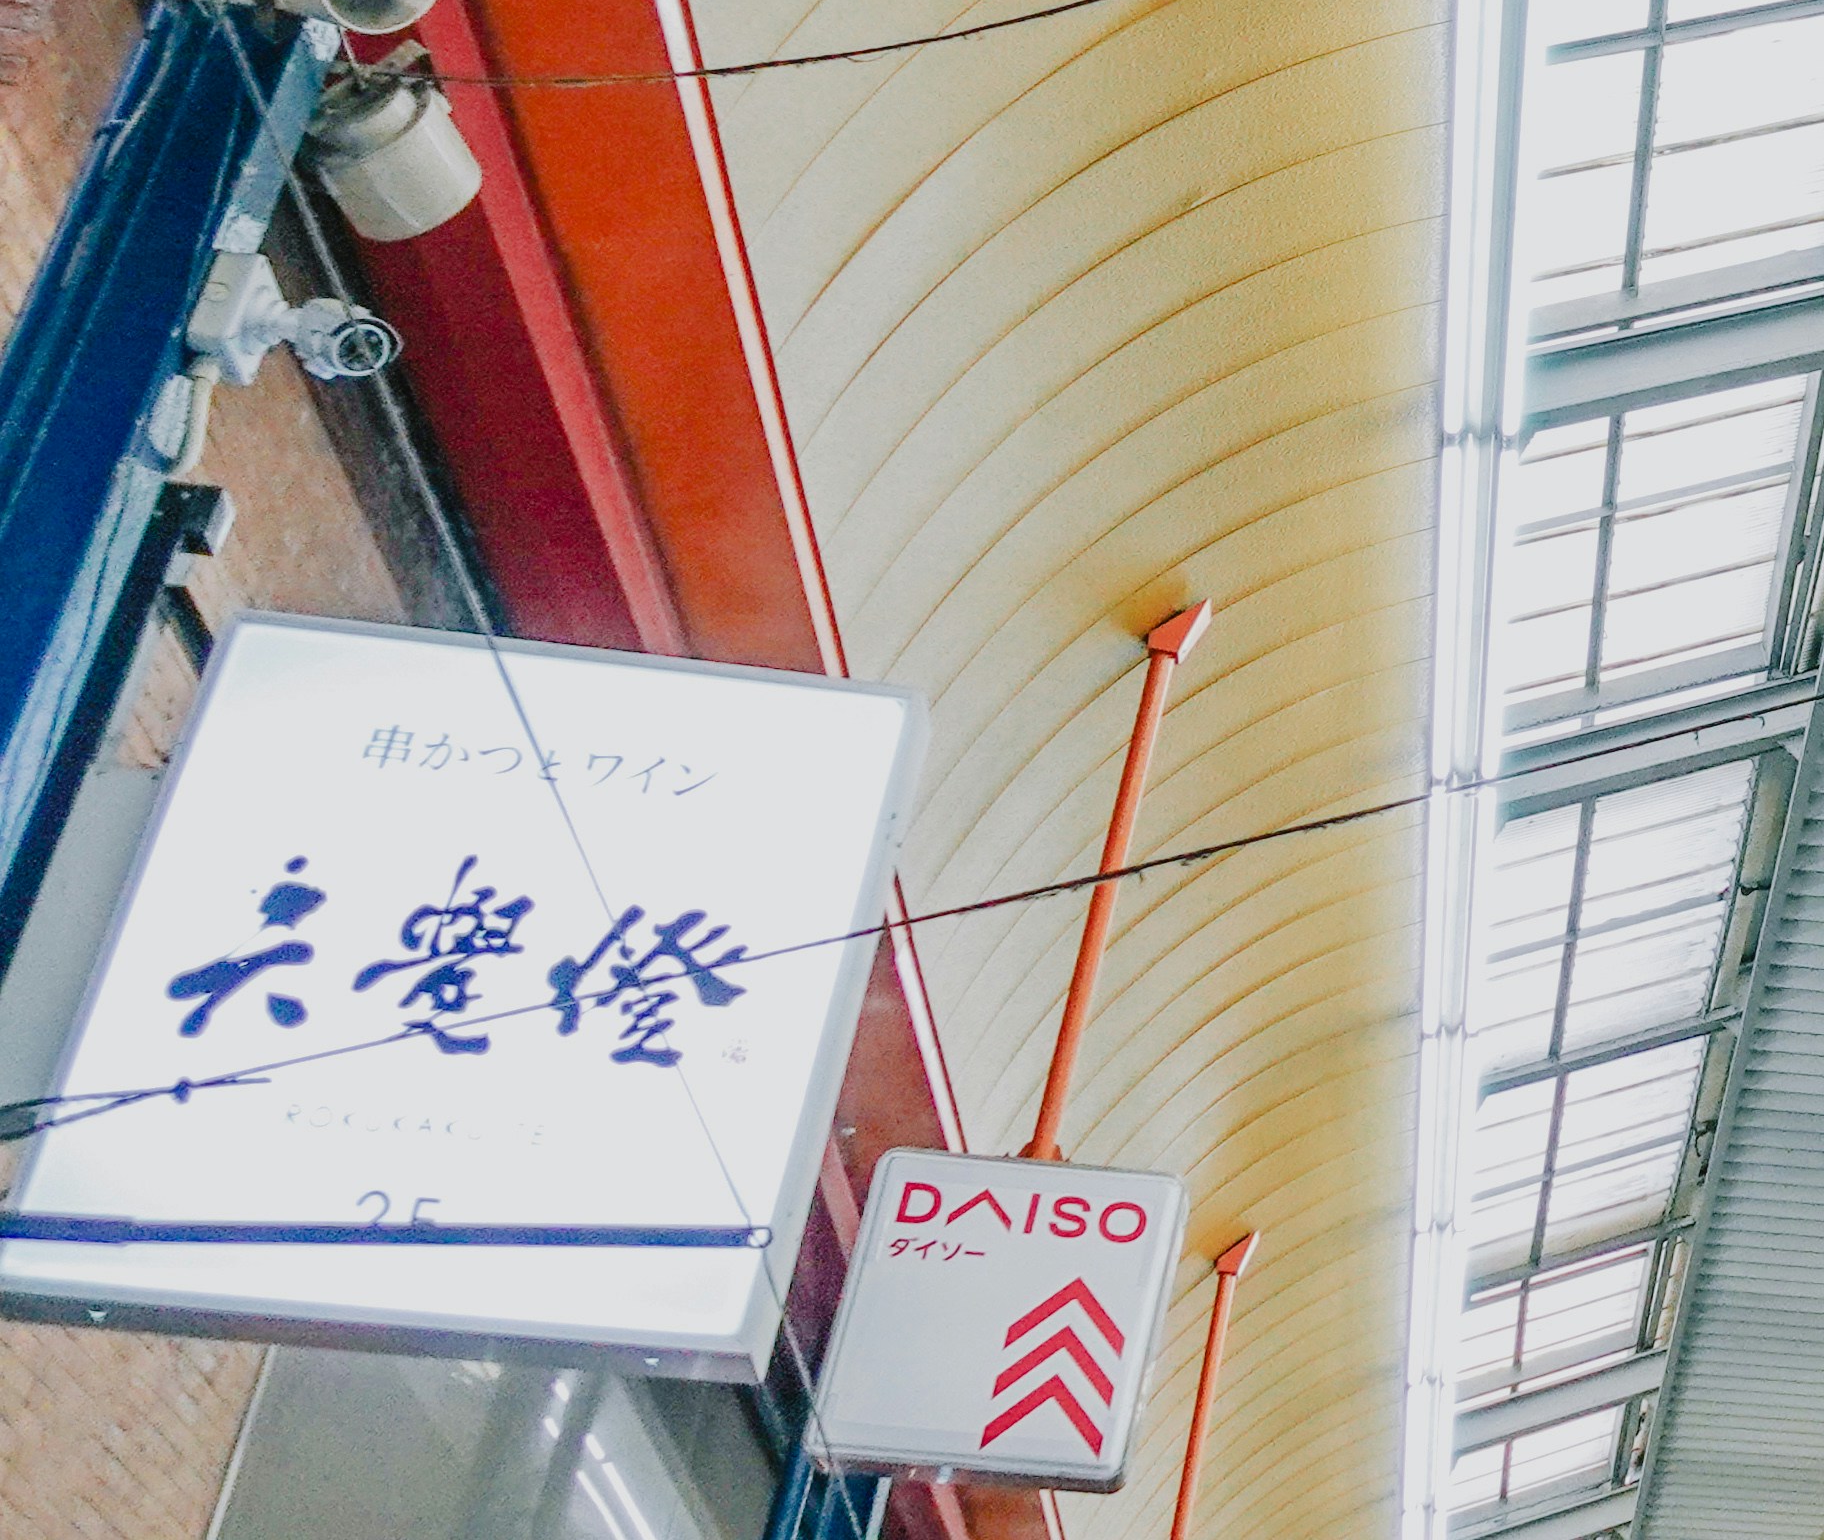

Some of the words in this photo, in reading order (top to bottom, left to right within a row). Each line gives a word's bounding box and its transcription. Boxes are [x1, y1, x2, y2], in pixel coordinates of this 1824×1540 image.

[362, 724, 718, 796] 串かつとワイン
[895, 1182, 1147, 1243] DAISO
[888, 1238, 986, 1261] ダイソー
